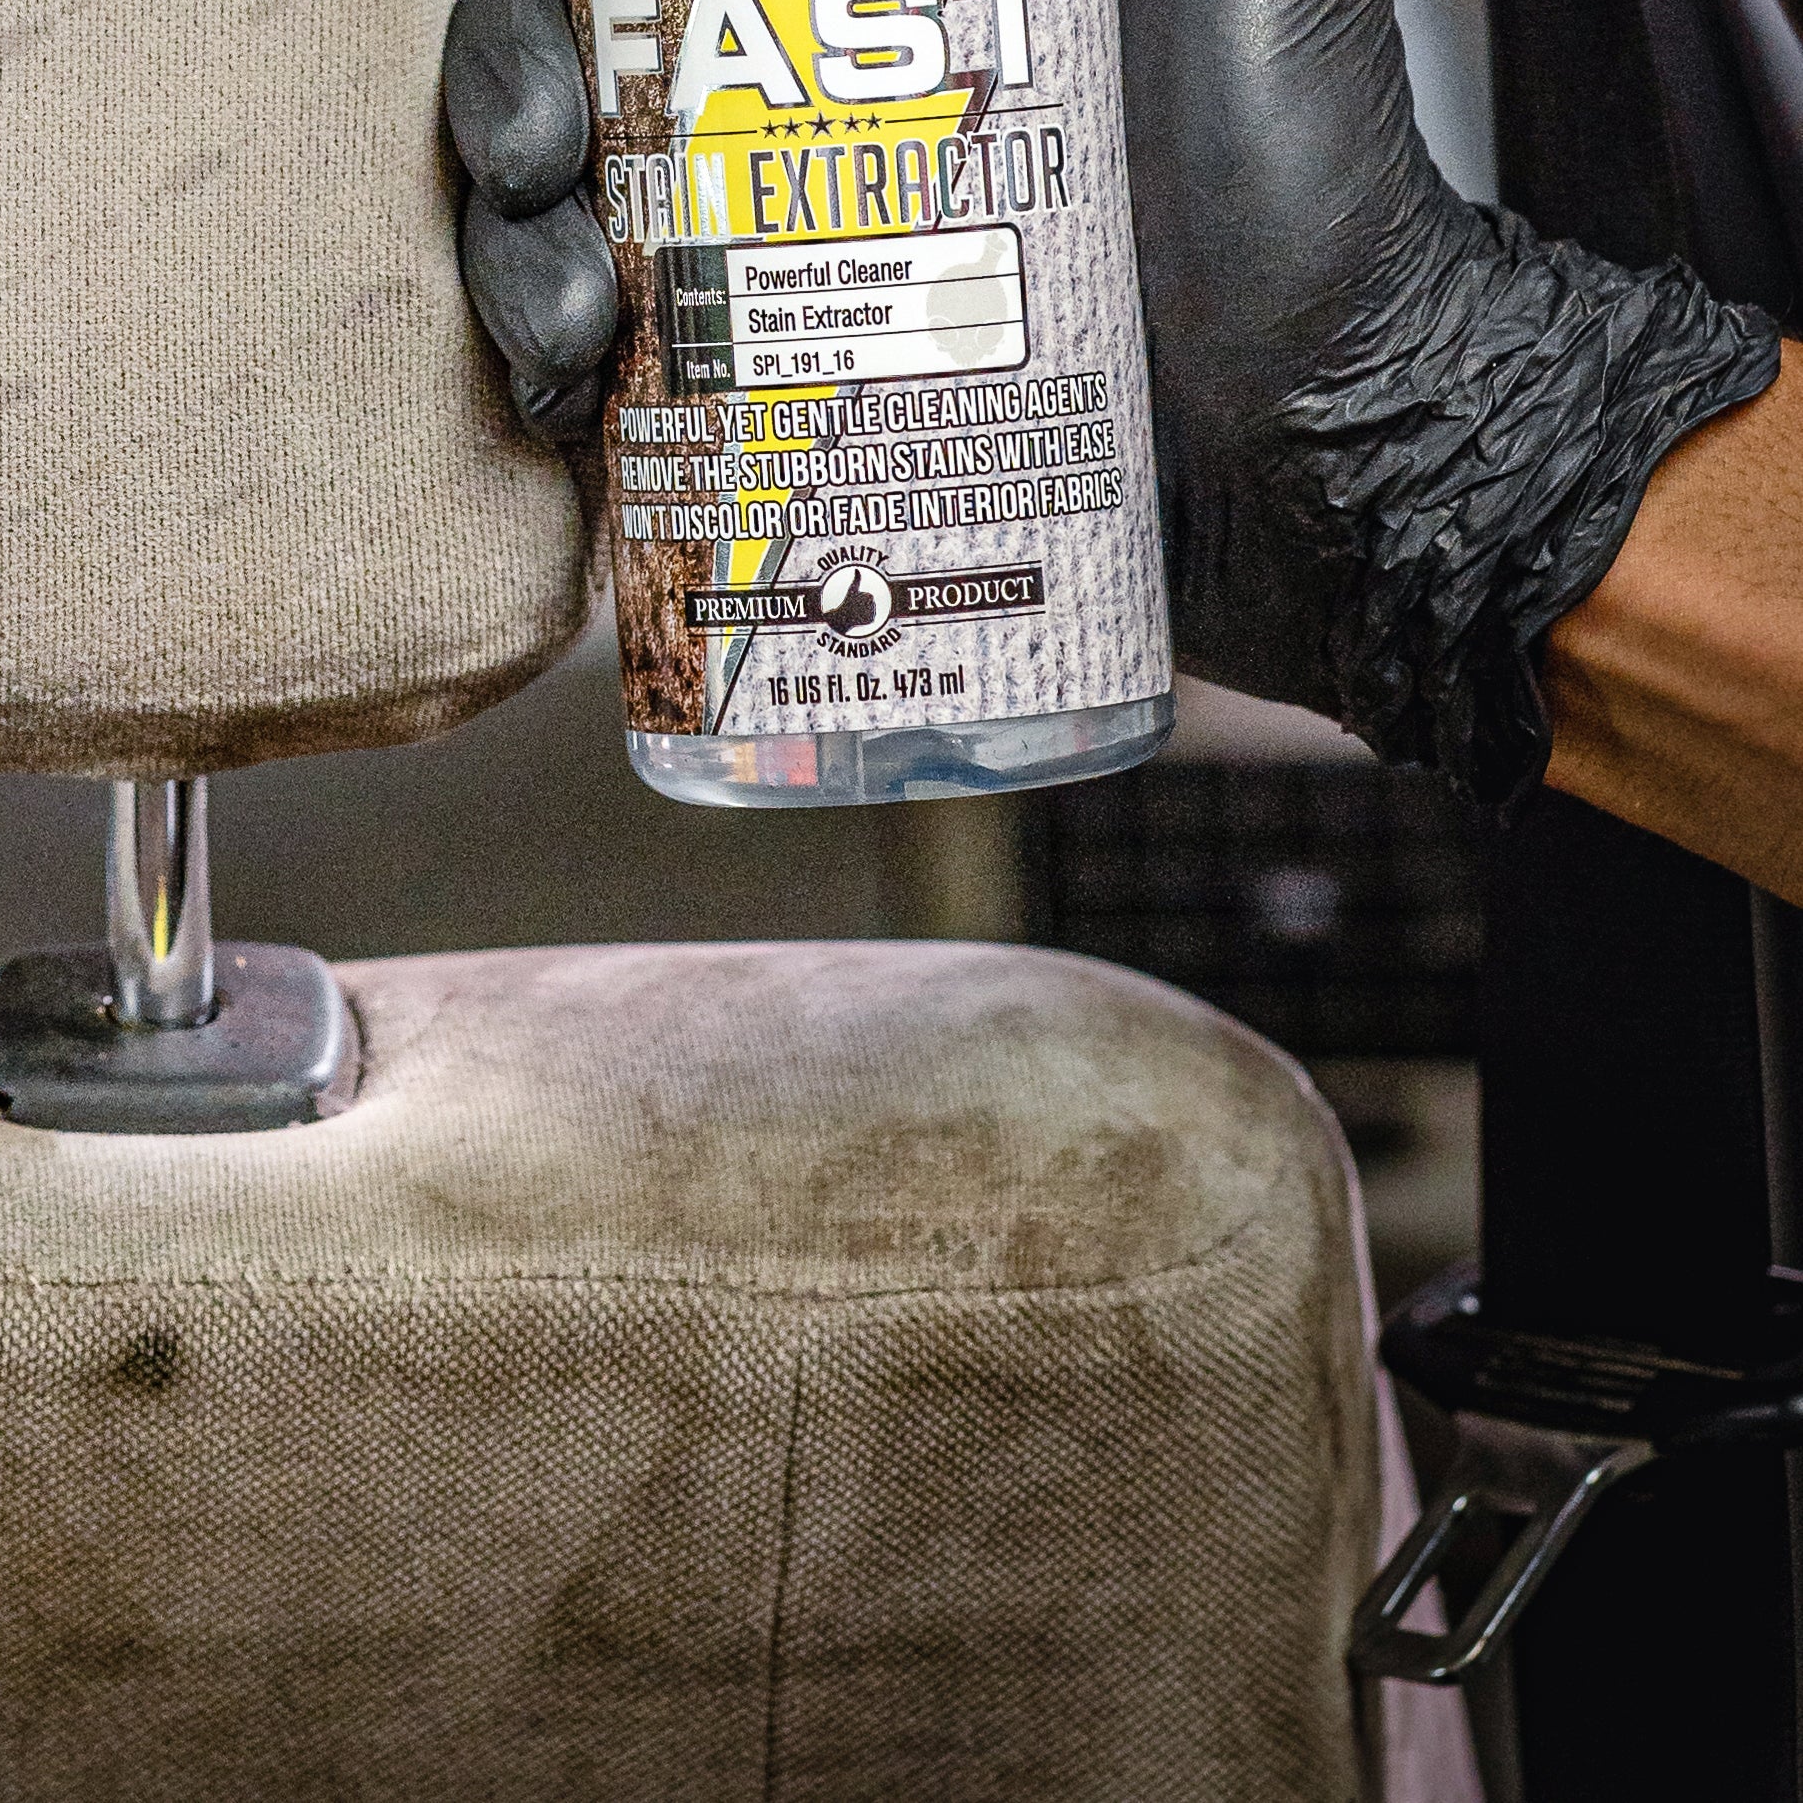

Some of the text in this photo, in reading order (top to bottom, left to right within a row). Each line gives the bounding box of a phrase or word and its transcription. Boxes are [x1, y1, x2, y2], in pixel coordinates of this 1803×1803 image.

[604, 126, 1070, 244] STAIN EXTRACTOR
[745, 259, 913, 291] Powerful Cleaner
[675, 287, 727, 308] Contents:
[748, 302, 893, 334] Stain Extractor
[686, 358, 731, 380] Item No.
[752, 349, 855, 379] SPI_191_16
[618, 371, 1107, 444] POWERFUL YET GENTLE CLEANING AGENTS
[620, 419, 1116, 492] REMOVE THE STUBBORN STAINS WITH EASE
[621, 467, 1123, 542] WON'T DISCOLOR OR FADE INTERIOR FABRICS
[817, 545, 889, 573] QUALITY
[695, 574, 1035, 623] PREMIUM PRODUCT
[816, 626, 903, 659] STANDARD
[767, 664, 966, 706] 16 US Fl. Oz. 473 ml
